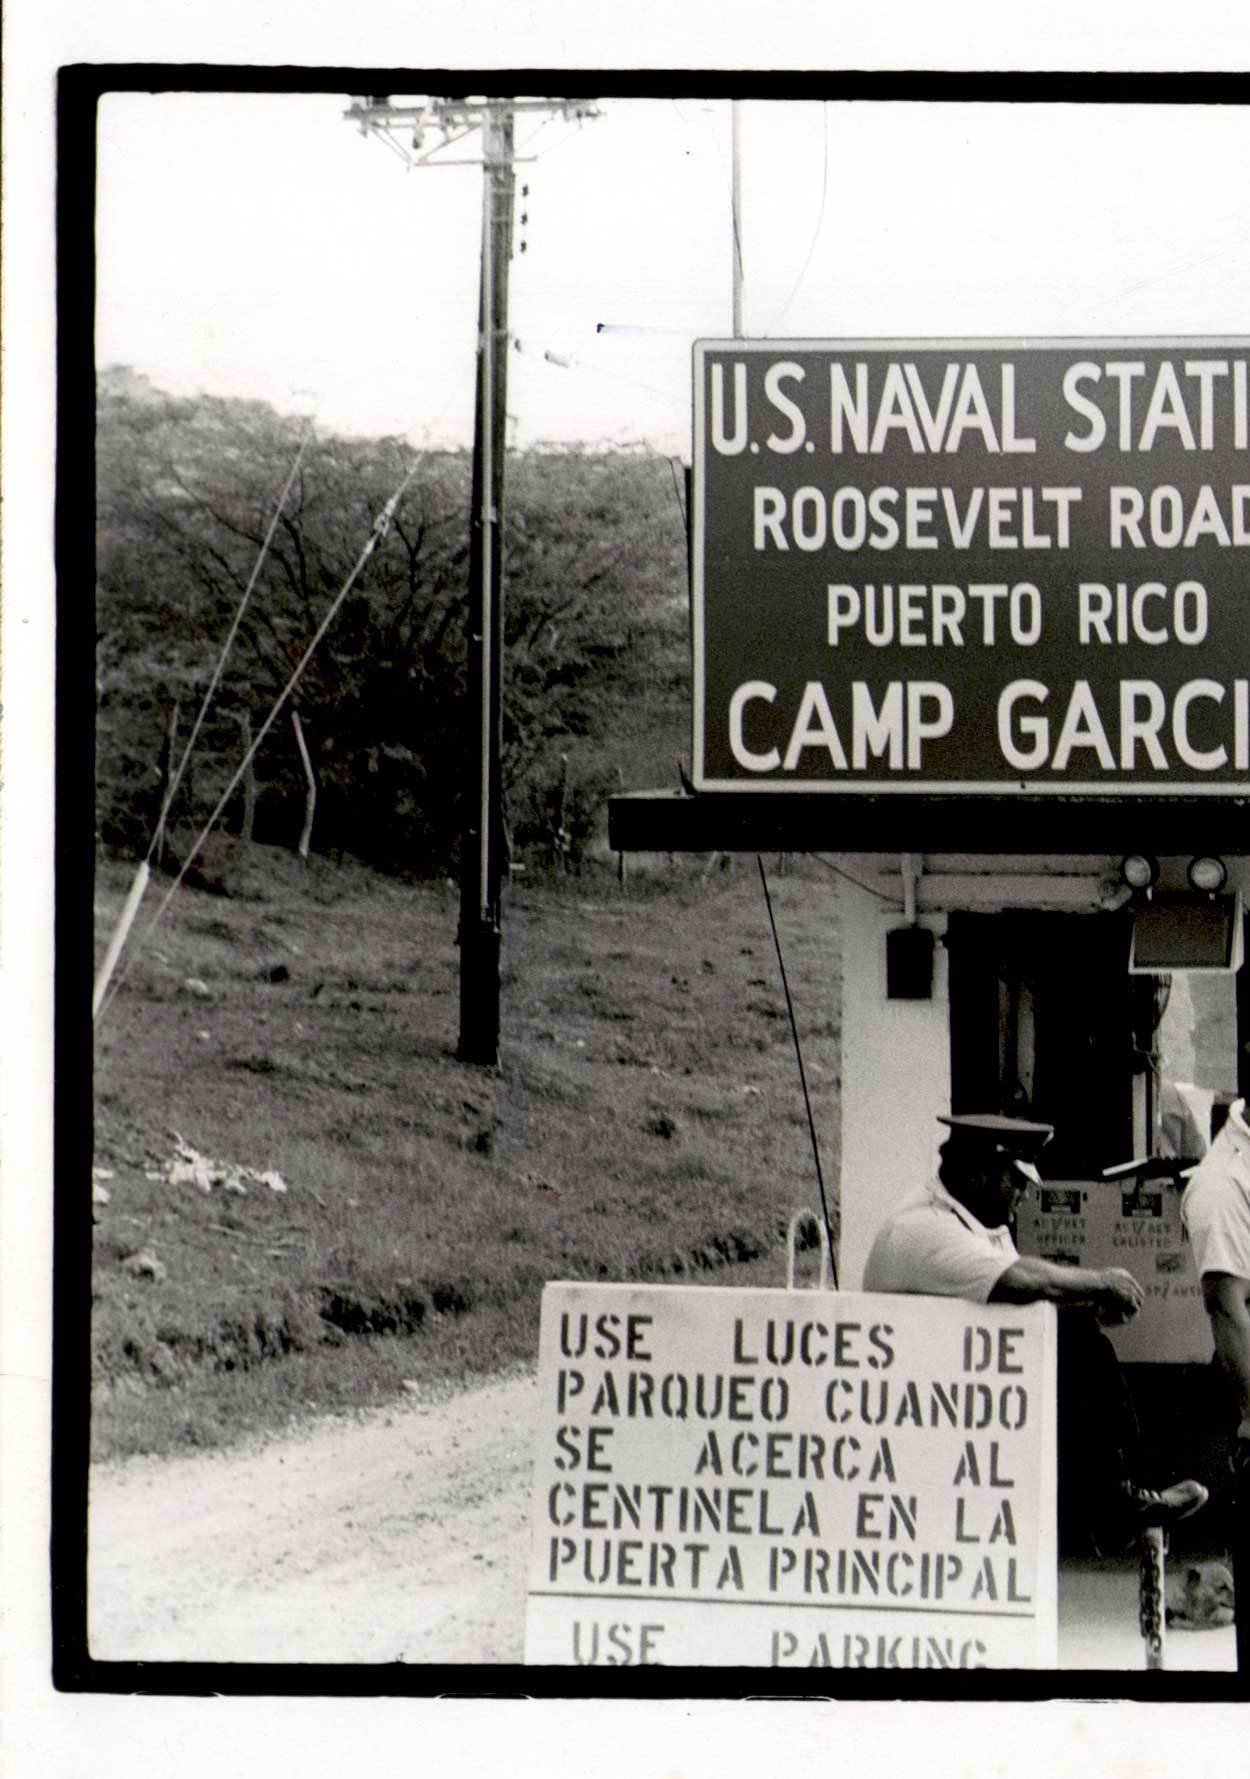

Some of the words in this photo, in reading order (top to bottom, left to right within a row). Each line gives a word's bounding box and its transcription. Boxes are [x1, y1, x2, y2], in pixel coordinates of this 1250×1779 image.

[712, 362, 814, 455] U.S.
[831, 363, 1036, 453] NAVAL
[755, 487, 1082, 550] ROOSEVELT
[828, 583, 1041, 646] PUERTO
[1079, 581, 1207, 644] RICO
[730, 681, 953, 771] CAMP
[561, 1313, 652, 1361] USE
[734, 1319, 893, 1368] LUCES
[964, 1327, 1024, 1374] DE
[558, 1370, 788, 1421] PARQUEO
[826, 1380, 1027, 1430] CUANDO
[555, 1426, 614, 1472] SE
[696, 1430, 895, 1482] ACERCA
[954, 1441, 1014, 1488] AL
[549, 1483, 819, 1536] CENTINELA
[856, 1493, 916, 1540] EN
[956, 1498, 1016, 1545] LA
[550, 1537, 743, 1589] PUERTA
[770, 1547, 1030, 1602] PRINCIPAL
[573, 1622, 665, 1664] USE
